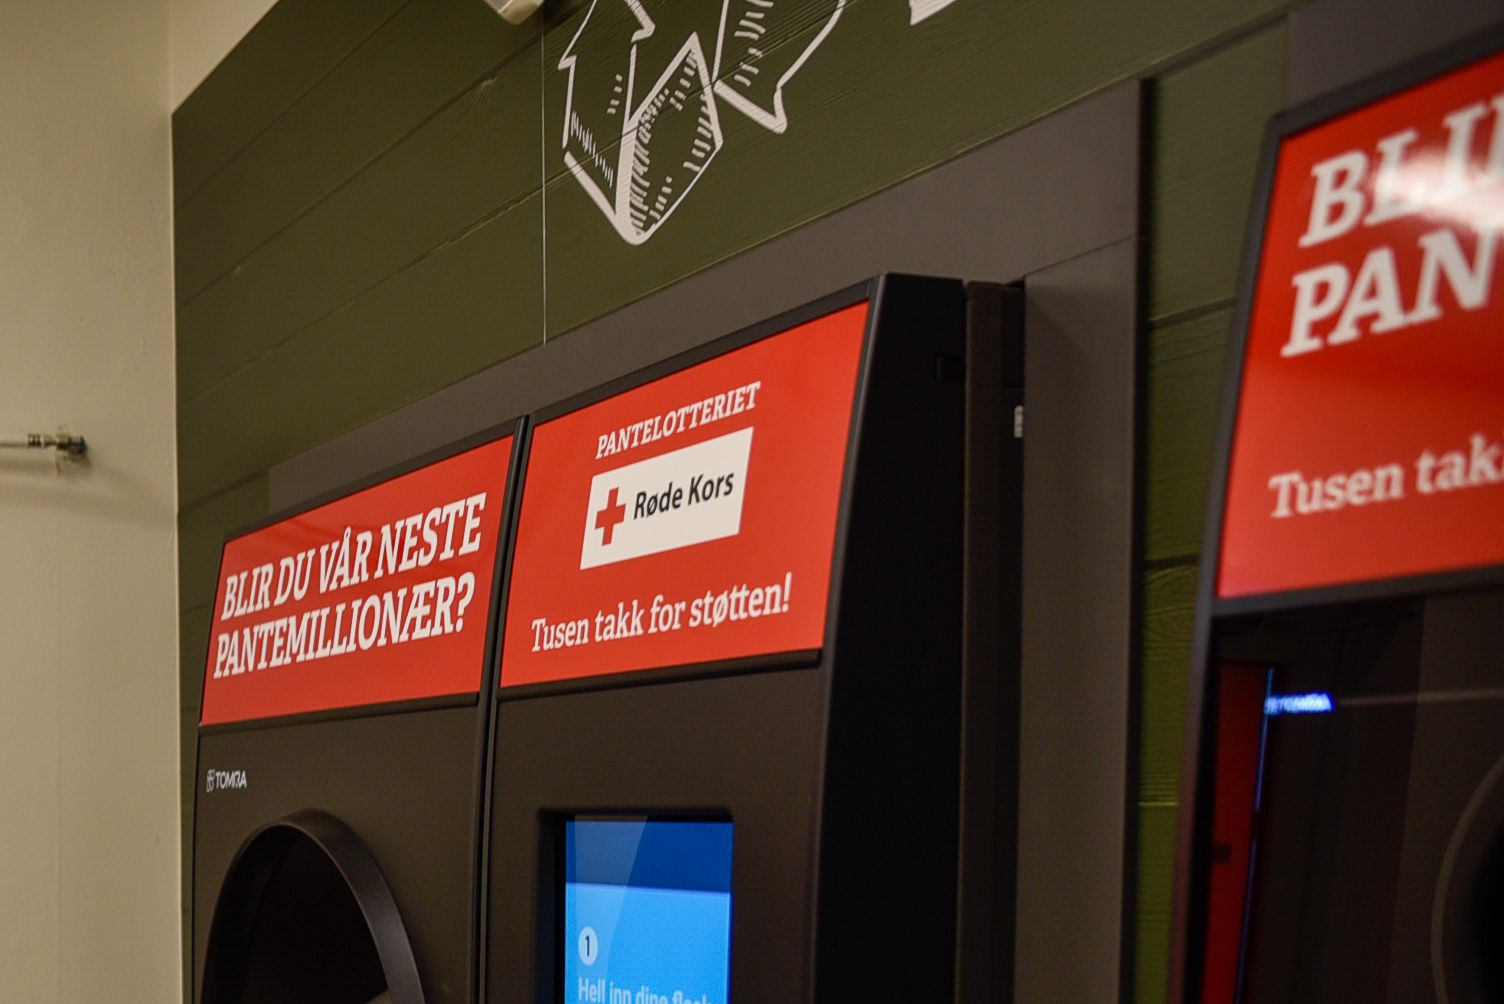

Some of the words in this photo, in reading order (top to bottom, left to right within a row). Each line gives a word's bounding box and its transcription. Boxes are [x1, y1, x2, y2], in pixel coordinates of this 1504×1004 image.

[595, 381, 762, 460] PANTELOTTERIET
[633, 482, 684, 520] Røde
[686, 472, 735, 507] Kors
[1267, 462, 1405, 519] Tusen
[1415, 430, 1504, 496] tak
[220, 563, 274, 621] BLIR
[273, 548, 316, 607] DU
[318, 525, 373, 594] VÅR
[374, 492, 487, 577] NESTE
[212, 571, 476, 679] PANTEMILLIONÆR?
[531, 618, 590, 653] Tusen
[594, 599, 645, 642] takk
[647, 594, 685, 634] for
[688, 571, 793, 628] støtten!
[578, 976, 606, 1004] Hell
